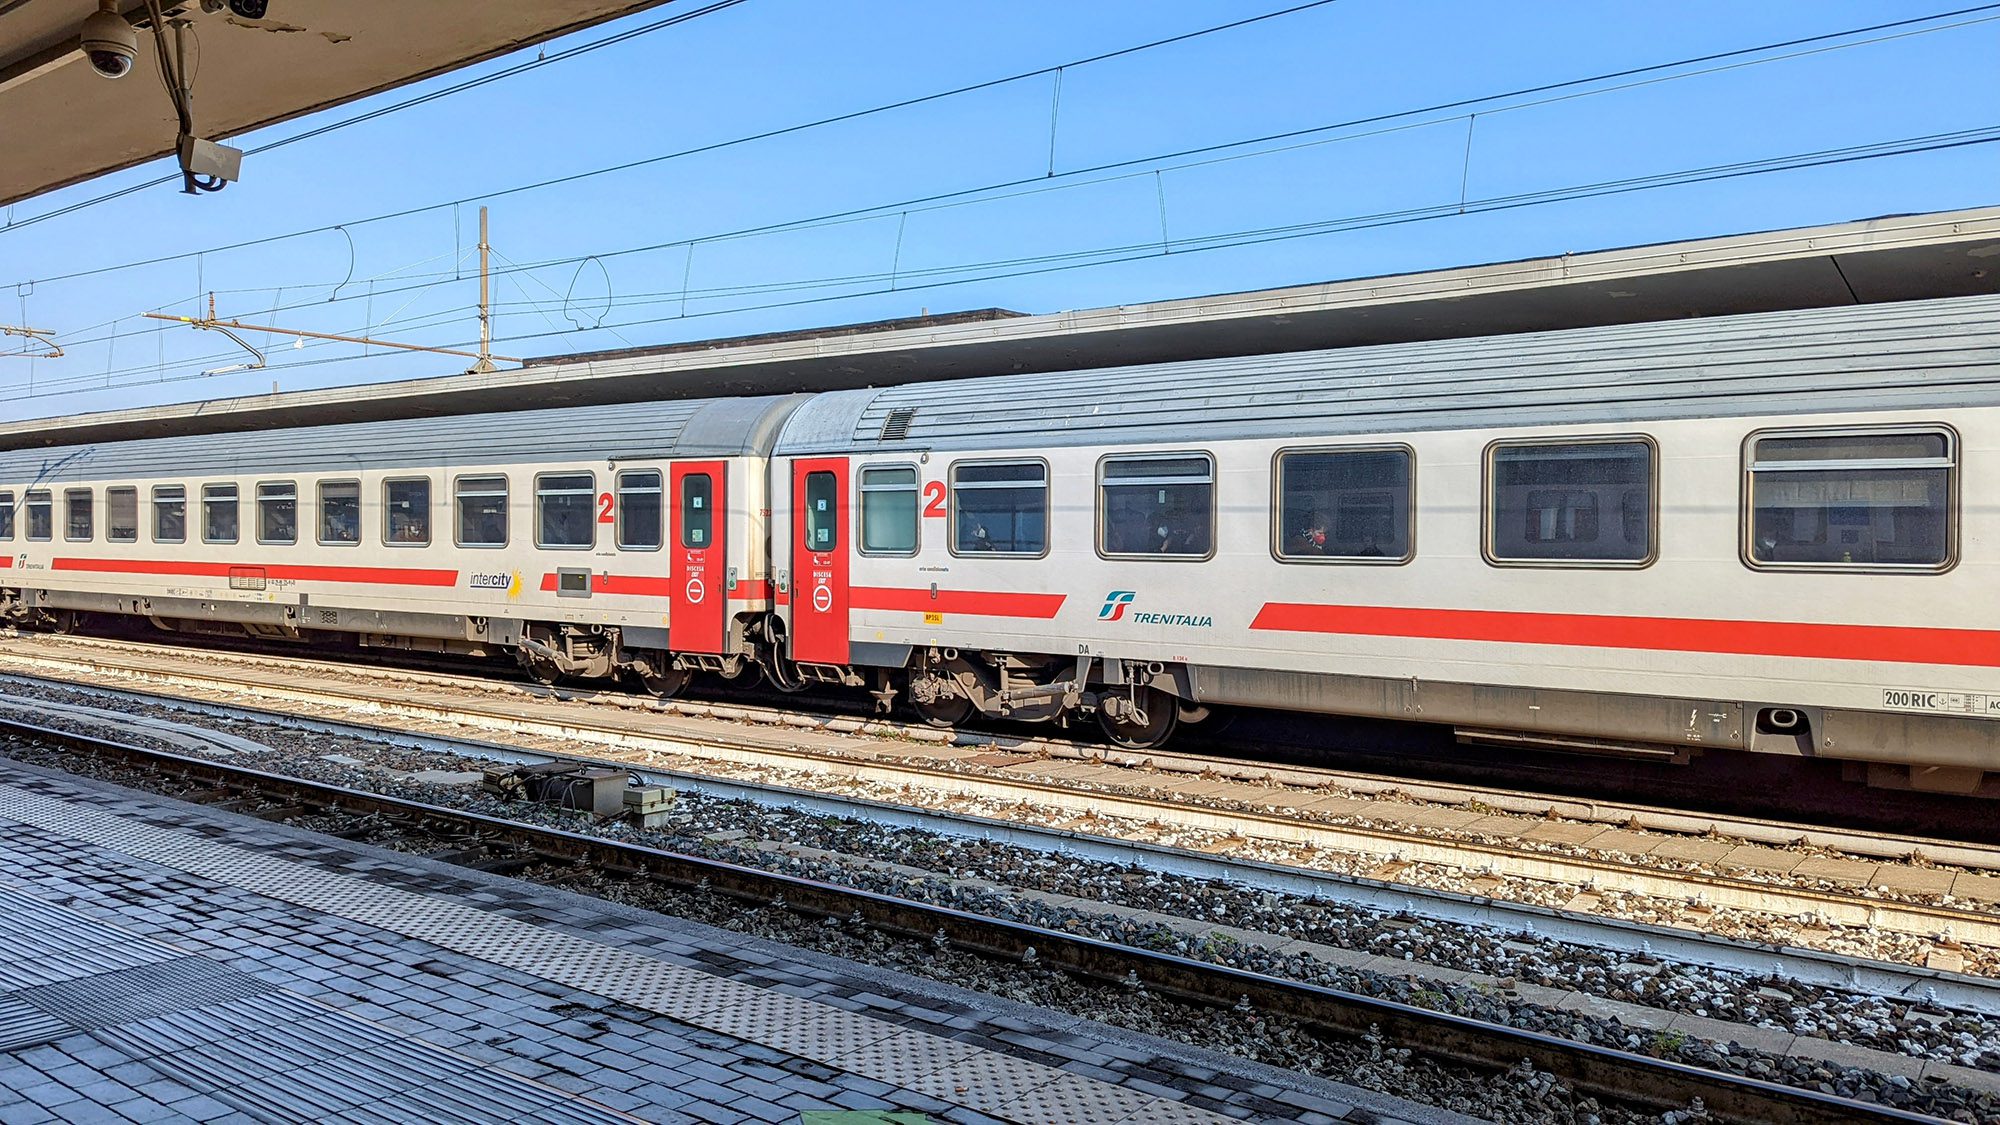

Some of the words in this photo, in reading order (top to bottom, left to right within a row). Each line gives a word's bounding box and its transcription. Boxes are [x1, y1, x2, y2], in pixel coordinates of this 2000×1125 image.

[923, 480, 947, 517] 2
[597, 492, 614, 523] 2
[470, 572, 511, 588] intercity
[1133, 612, 1213, 627] TRENITALIA
[1078, 643, 1090, 655] DA
[1885, 691, 1909, 706] 200
[1911, 693, 1936, 708] RIC
